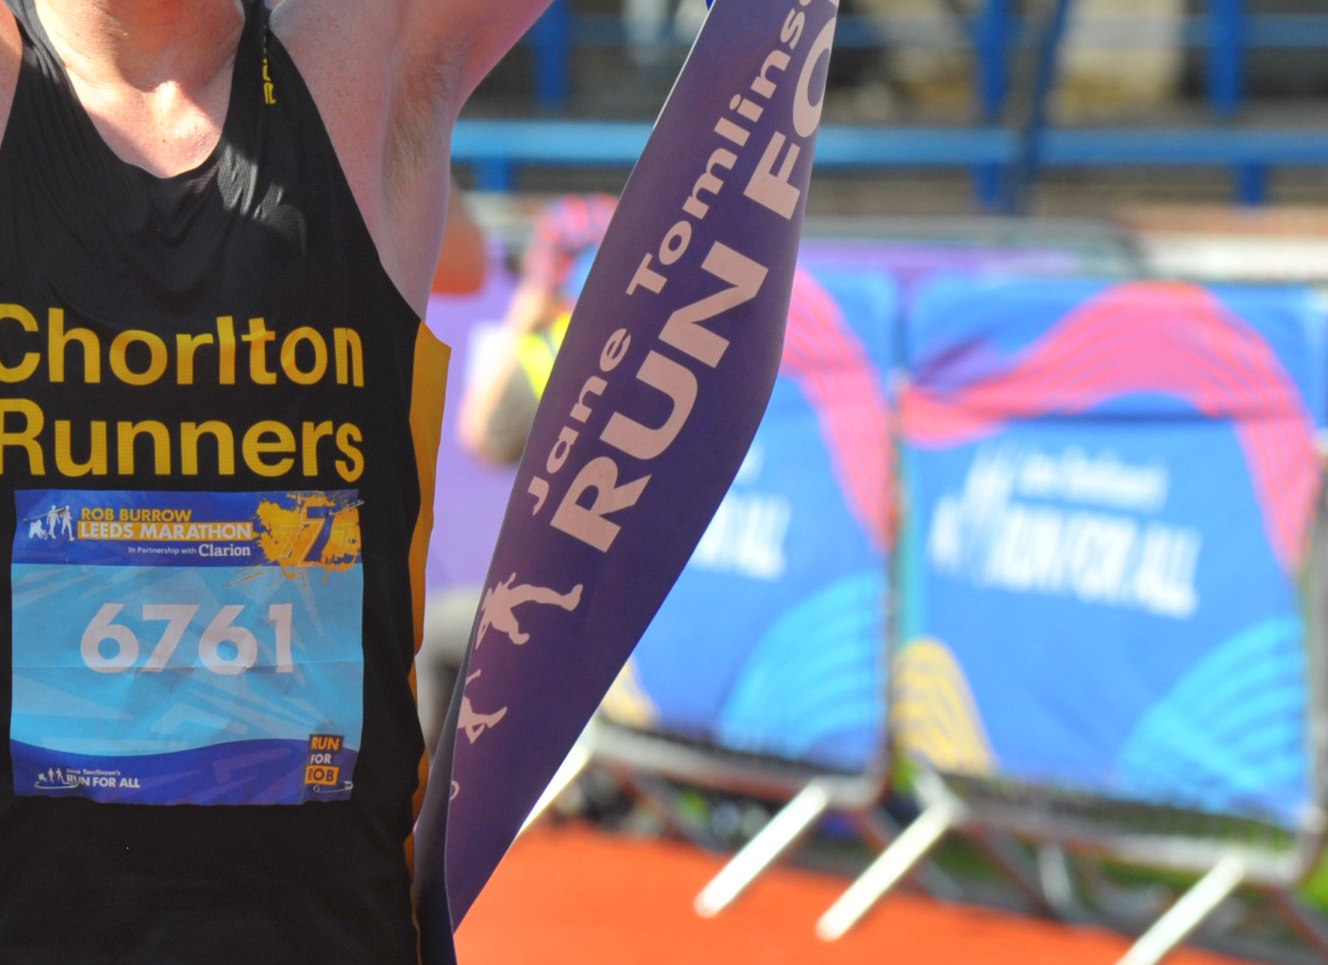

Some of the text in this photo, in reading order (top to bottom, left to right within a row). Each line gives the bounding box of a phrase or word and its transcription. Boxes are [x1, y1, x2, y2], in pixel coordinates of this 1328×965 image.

[550, 241, 769, 553] RUN
[527, 328, 632, 516] Jane
[81, 507, 192, 522] ROB BURROW
[81, 522, 252, 539] LEEDS MARATHON
[128, 543, 251, 557] In Partnership with Clarion
[80, 603, 293, 675] 6761
[311, 736, 340, 750] RUN
[310, 753, 332, 764] FOR
[93, 776, 116, 787] FOR
[119, 777, 141, 788] ALL
[307, 768, 335, 782] ROB
